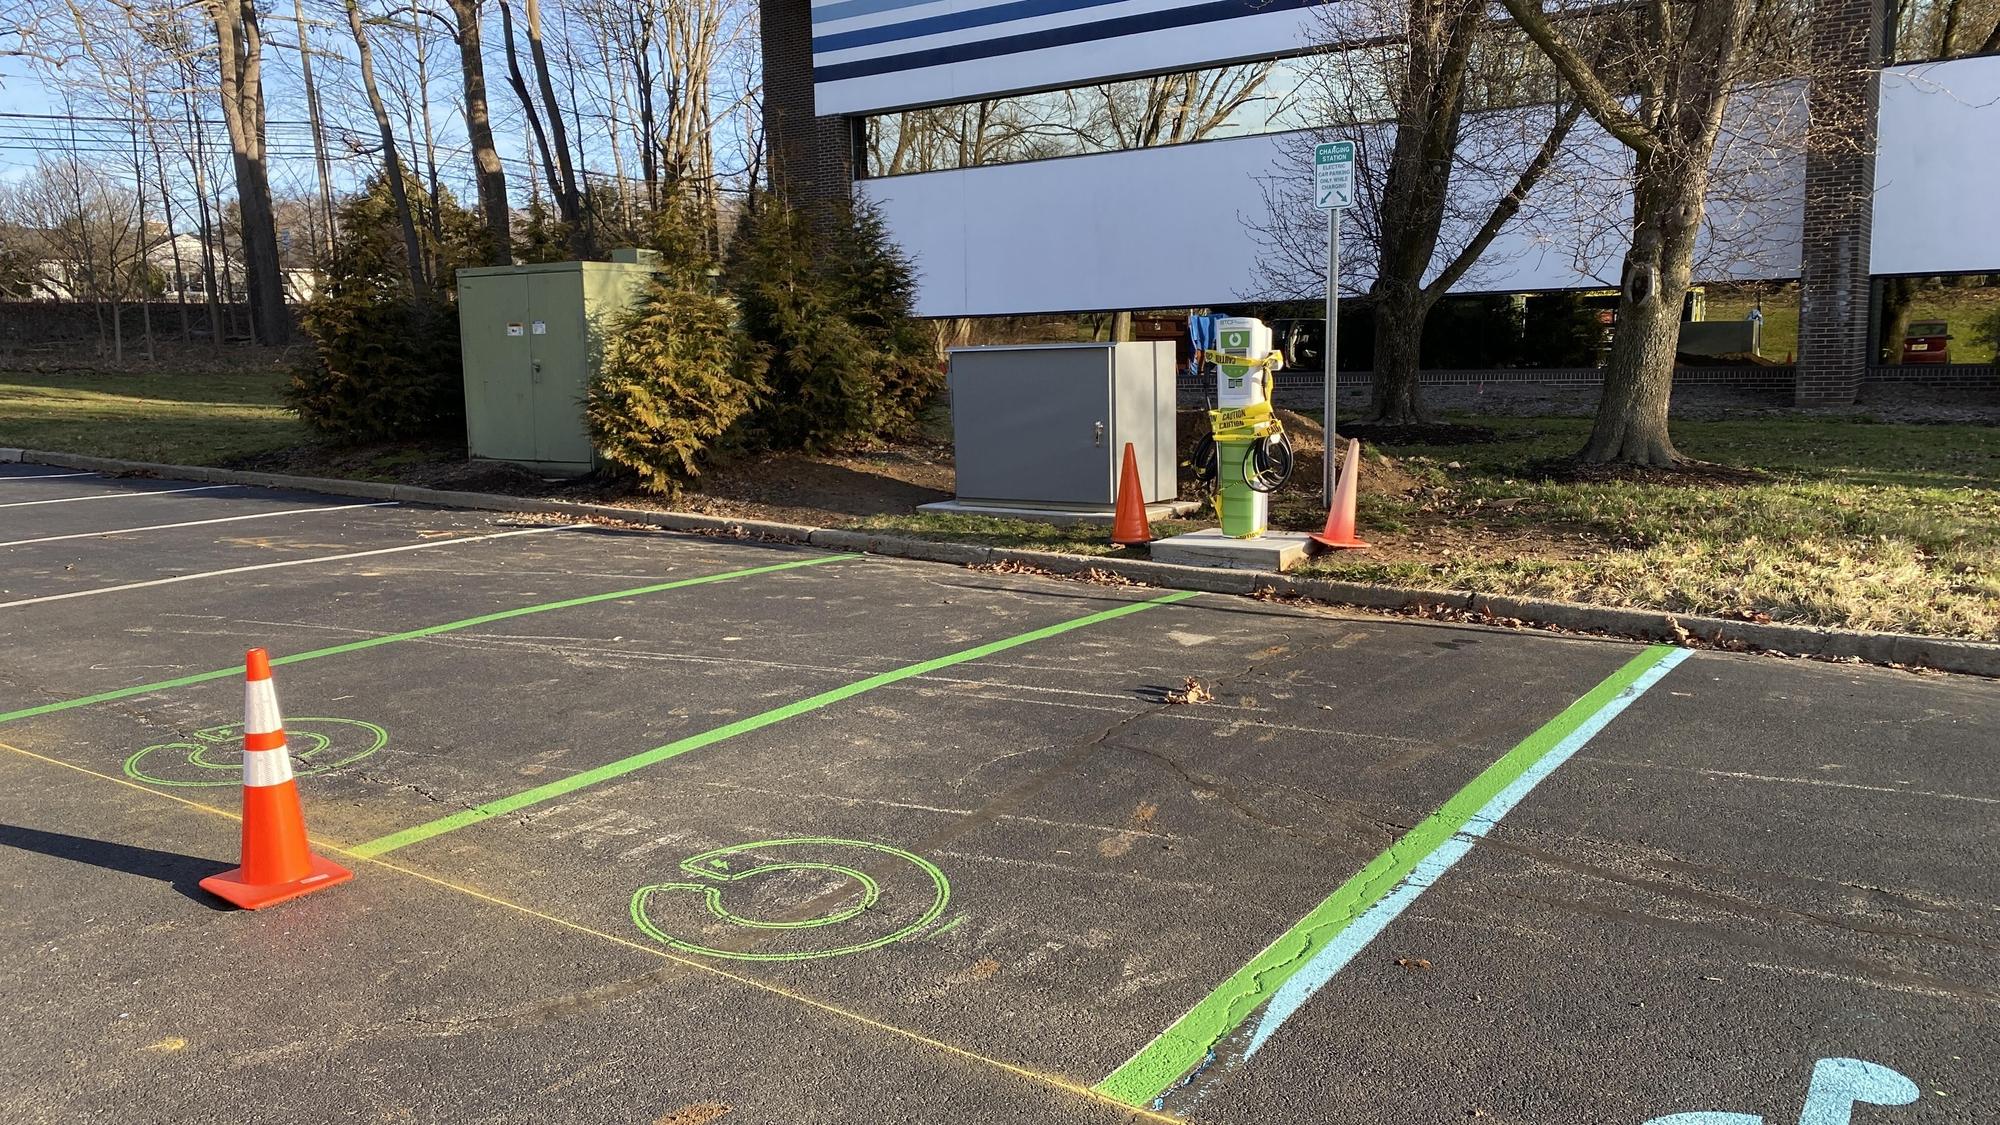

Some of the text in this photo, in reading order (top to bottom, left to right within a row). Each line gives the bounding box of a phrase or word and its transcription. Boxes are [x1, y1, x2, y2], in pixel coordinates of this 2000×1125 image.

[1320, 146, 1350, 155] CHARGING
[1222, 409, 1246, 421] CAUTION
[1218, 420, 1245, 430] CAUTION
